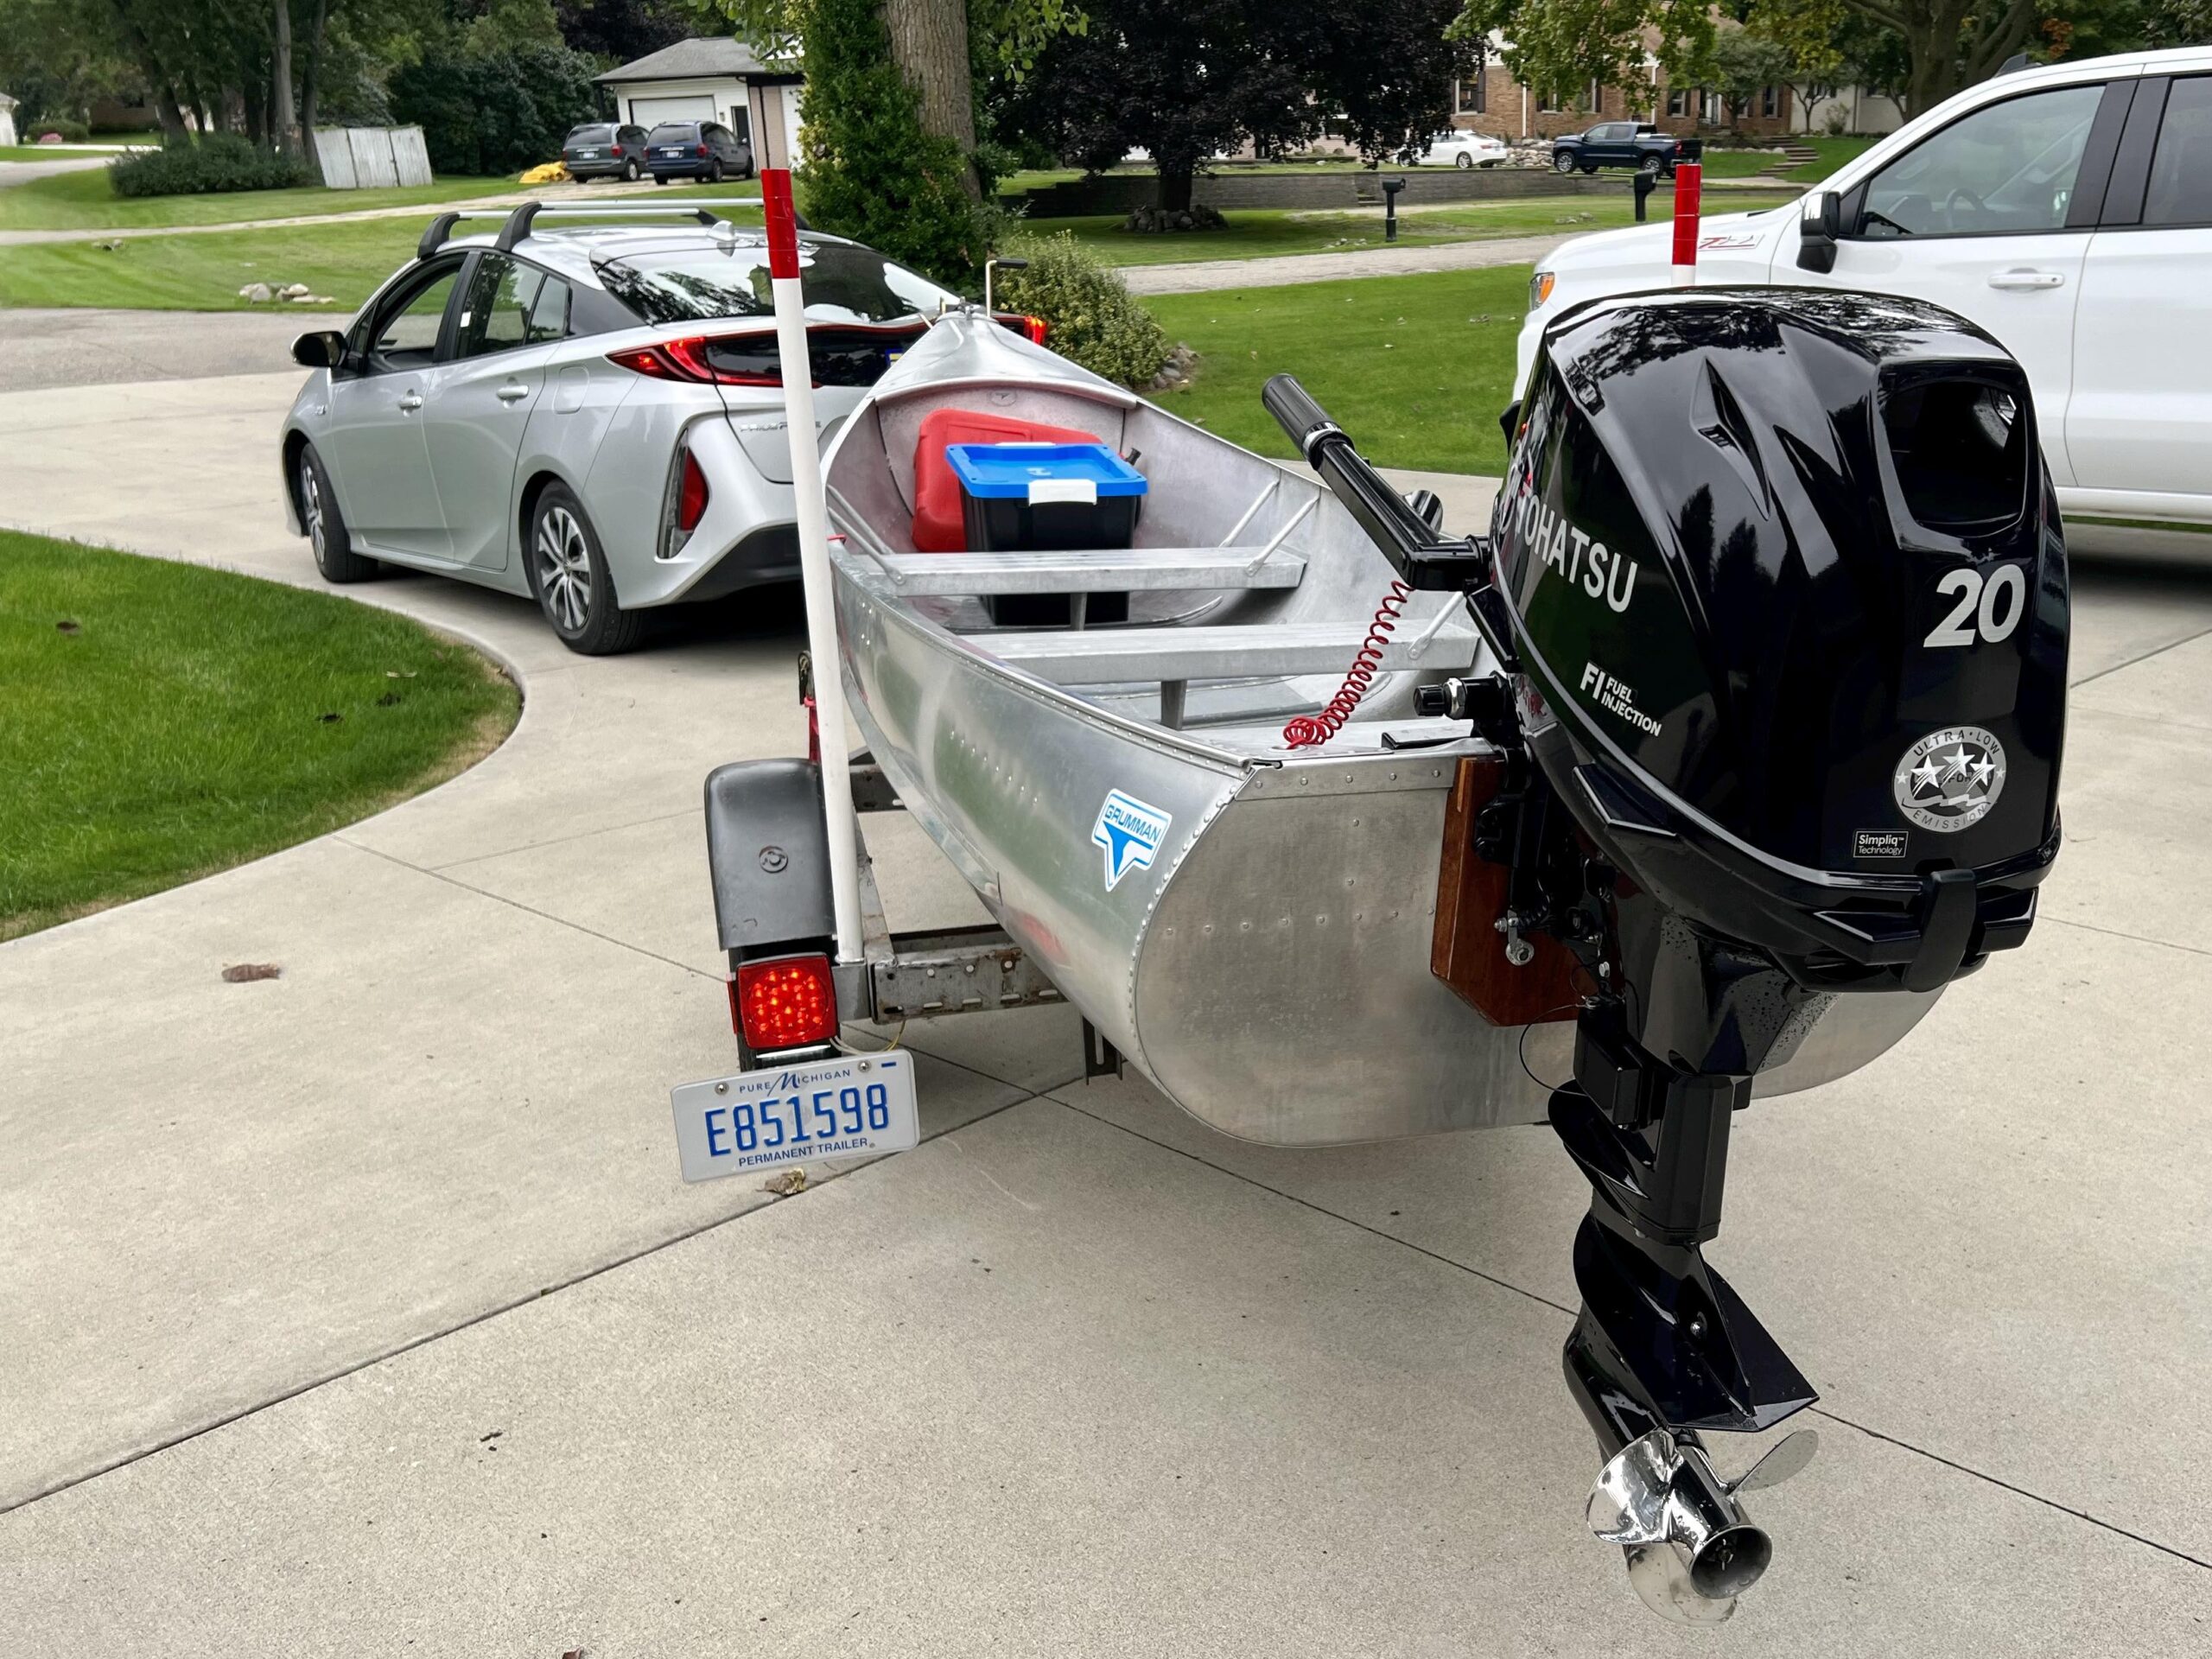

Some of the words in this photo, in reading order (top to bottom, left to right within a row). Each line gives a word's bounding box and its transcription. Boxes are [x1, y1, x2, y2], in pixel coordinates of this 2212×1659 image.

[1923, 563, 2026, 648] 20
[1580, 662, 1606, 700] FI
[1605, 676, 1632, 704] FUEL
[1600, 690, 1662, 737] INJECTION
[1913, 729, 1965, 757] ULTRA
[1976, 731, 2000, 755] LOW
[1104, 804, 1162, 843] GRUMMAN
[1912, 804, 1987, 830] EMISSION
[1858, 845, 1903, 856] Technology
[740, 1081, 771, 1093] PURE
[766, 1070, 851, 1097] MICHIGAN
[704, 1084, 889, 1157] E851598
[738, 1146, 814, 1167] PERMANENT
[818, 1137, 868, 1154] TRAILER
